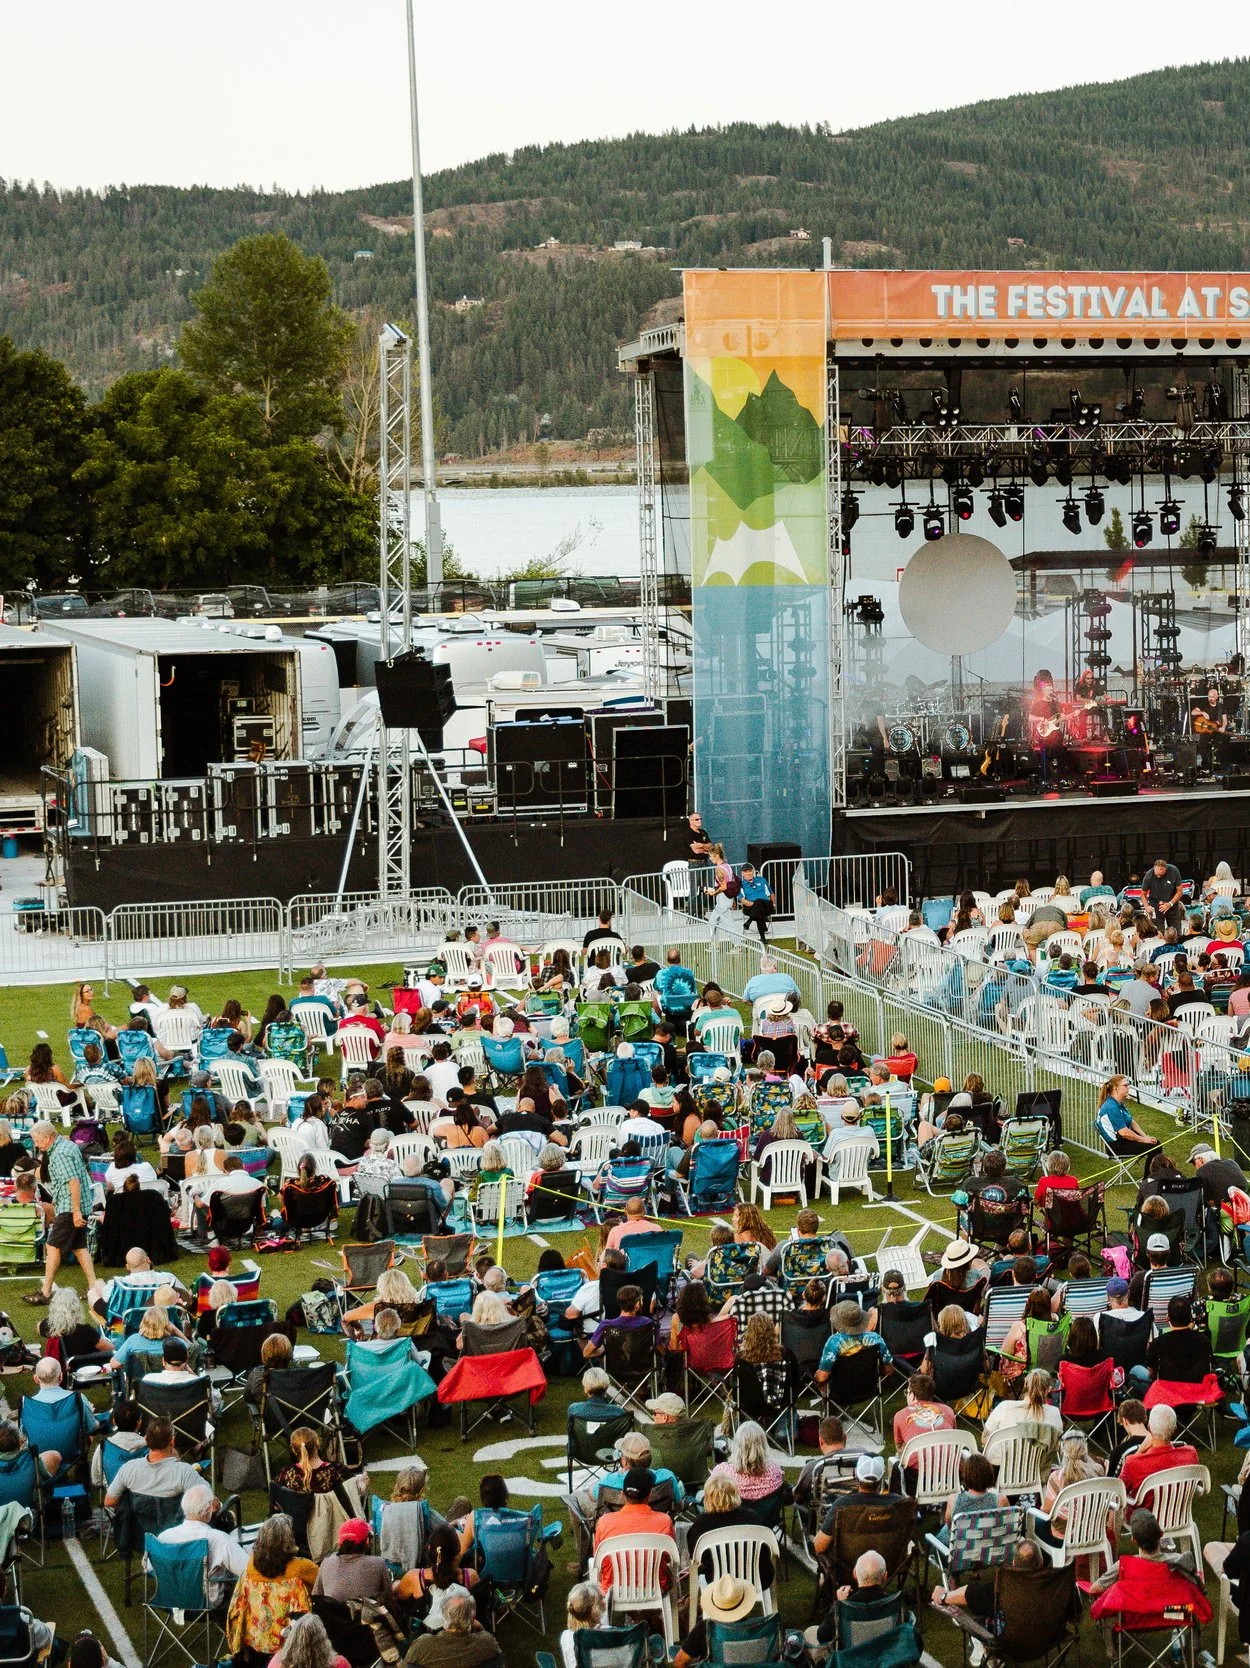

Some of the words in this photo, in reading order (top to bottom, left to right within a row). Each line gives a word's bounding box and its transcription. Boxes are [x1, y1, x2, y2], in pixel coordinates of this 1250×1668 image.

[931, 284, 998, 319] THE
[1007, 284, 1170, 319] FESTIVAL
[1176, 286, 1222, 318] AT
